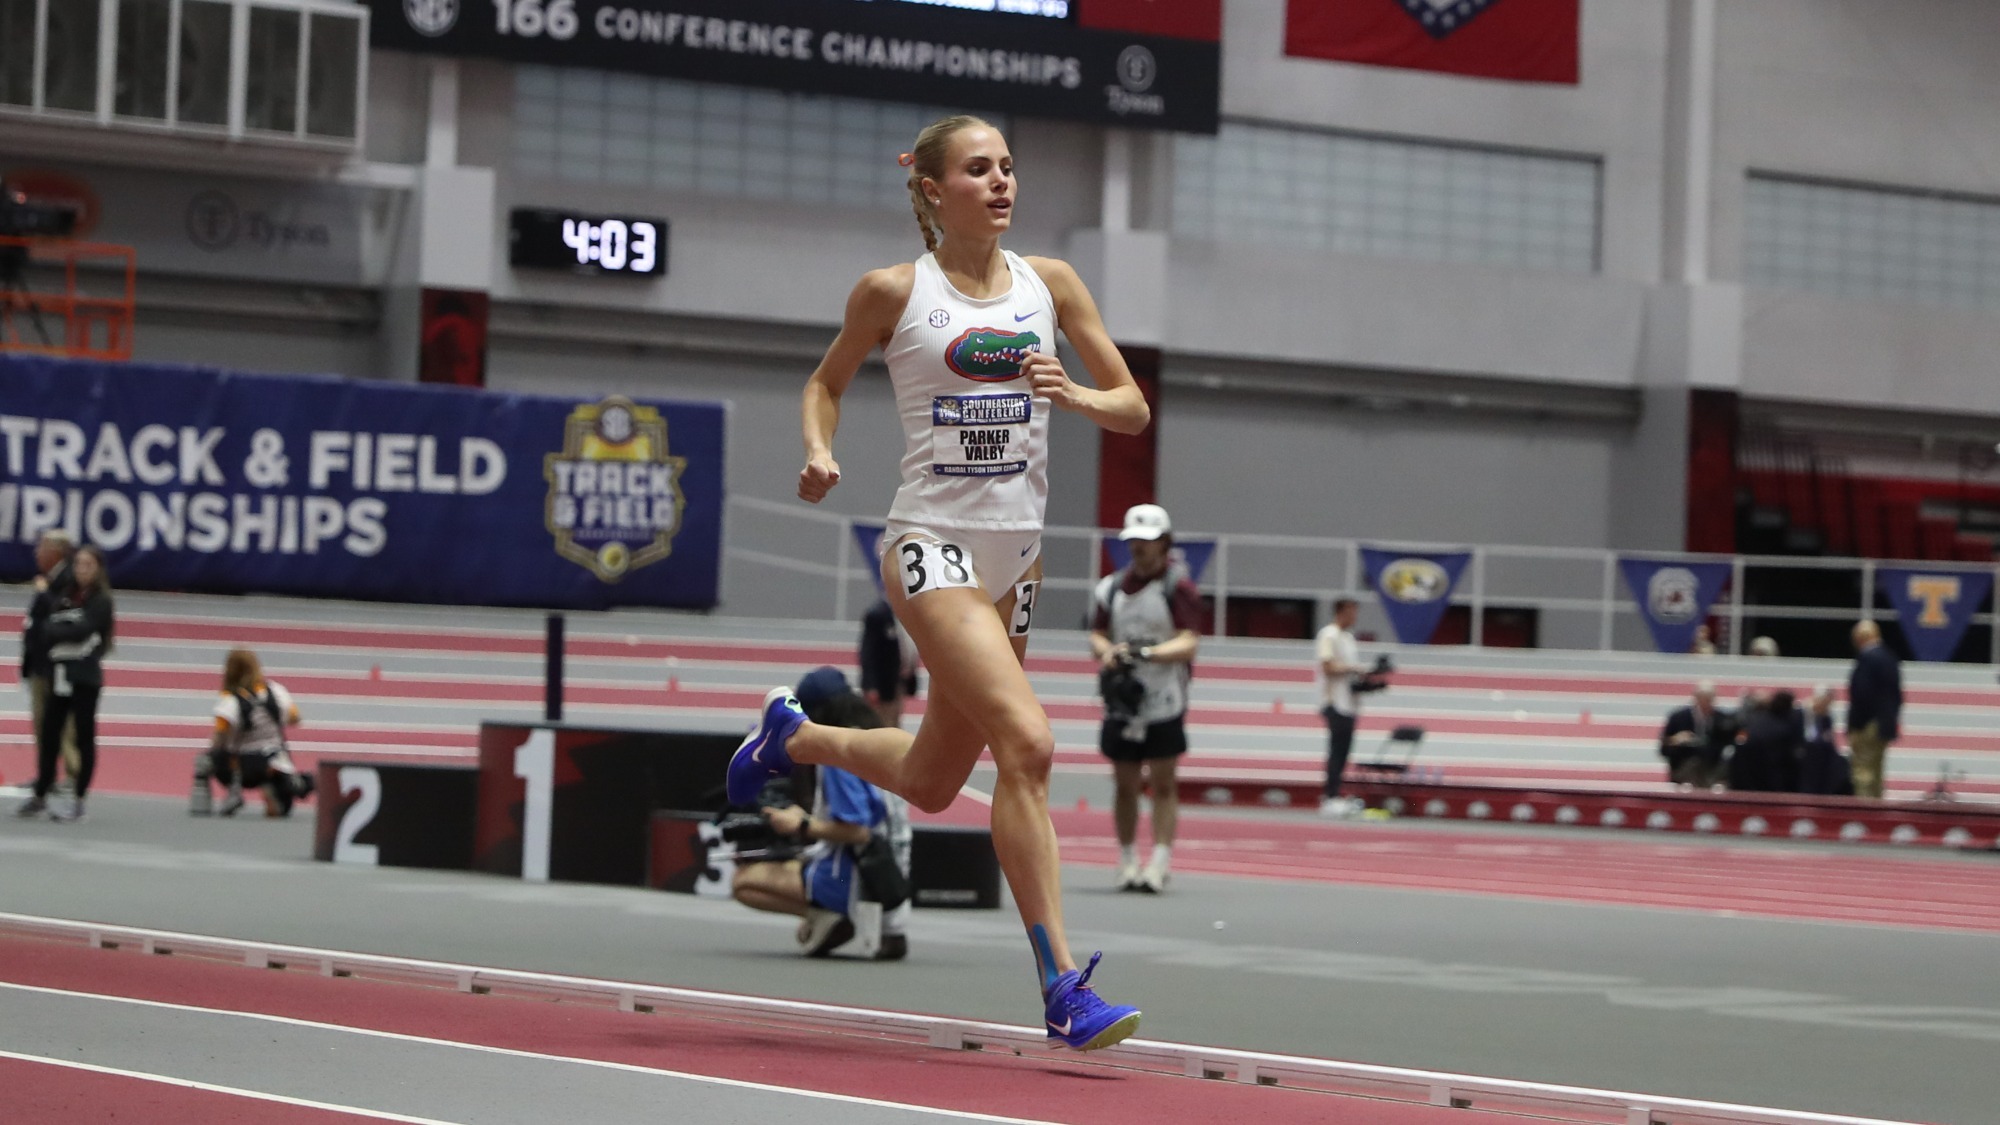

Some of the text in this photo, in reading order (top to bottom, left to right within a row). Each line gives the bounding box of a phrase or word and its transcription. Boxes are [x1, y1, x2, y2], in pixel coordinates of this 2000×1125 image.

[494, 0, 579, 41] 166
[595, 6, 813, 60] CONFERENCE
[821, 31, 1082, 89] CHAMPIONSHIPS
[563, 218, 656, 272] 4:03
[929, 310, 950, 327] SEC
[962, 398, 1025, 409] SOUTHEASTERN
[963, 407, 1025, 418] CONFERENCE
[0, 414, 507, 495] TRACK & FIELD
[960, 429, 1009, 445] PARKER
[965, 445, 1005, 460] VALBY
[553, 461, 674, 496] TRACK
[582, 496, 675, 530] FIELD
[902, 542, 969, 594] 38
[1907, 575, 1962, 628] T
[333, 766, 382, 865] 2
[514, 729, 556, 881] 1
